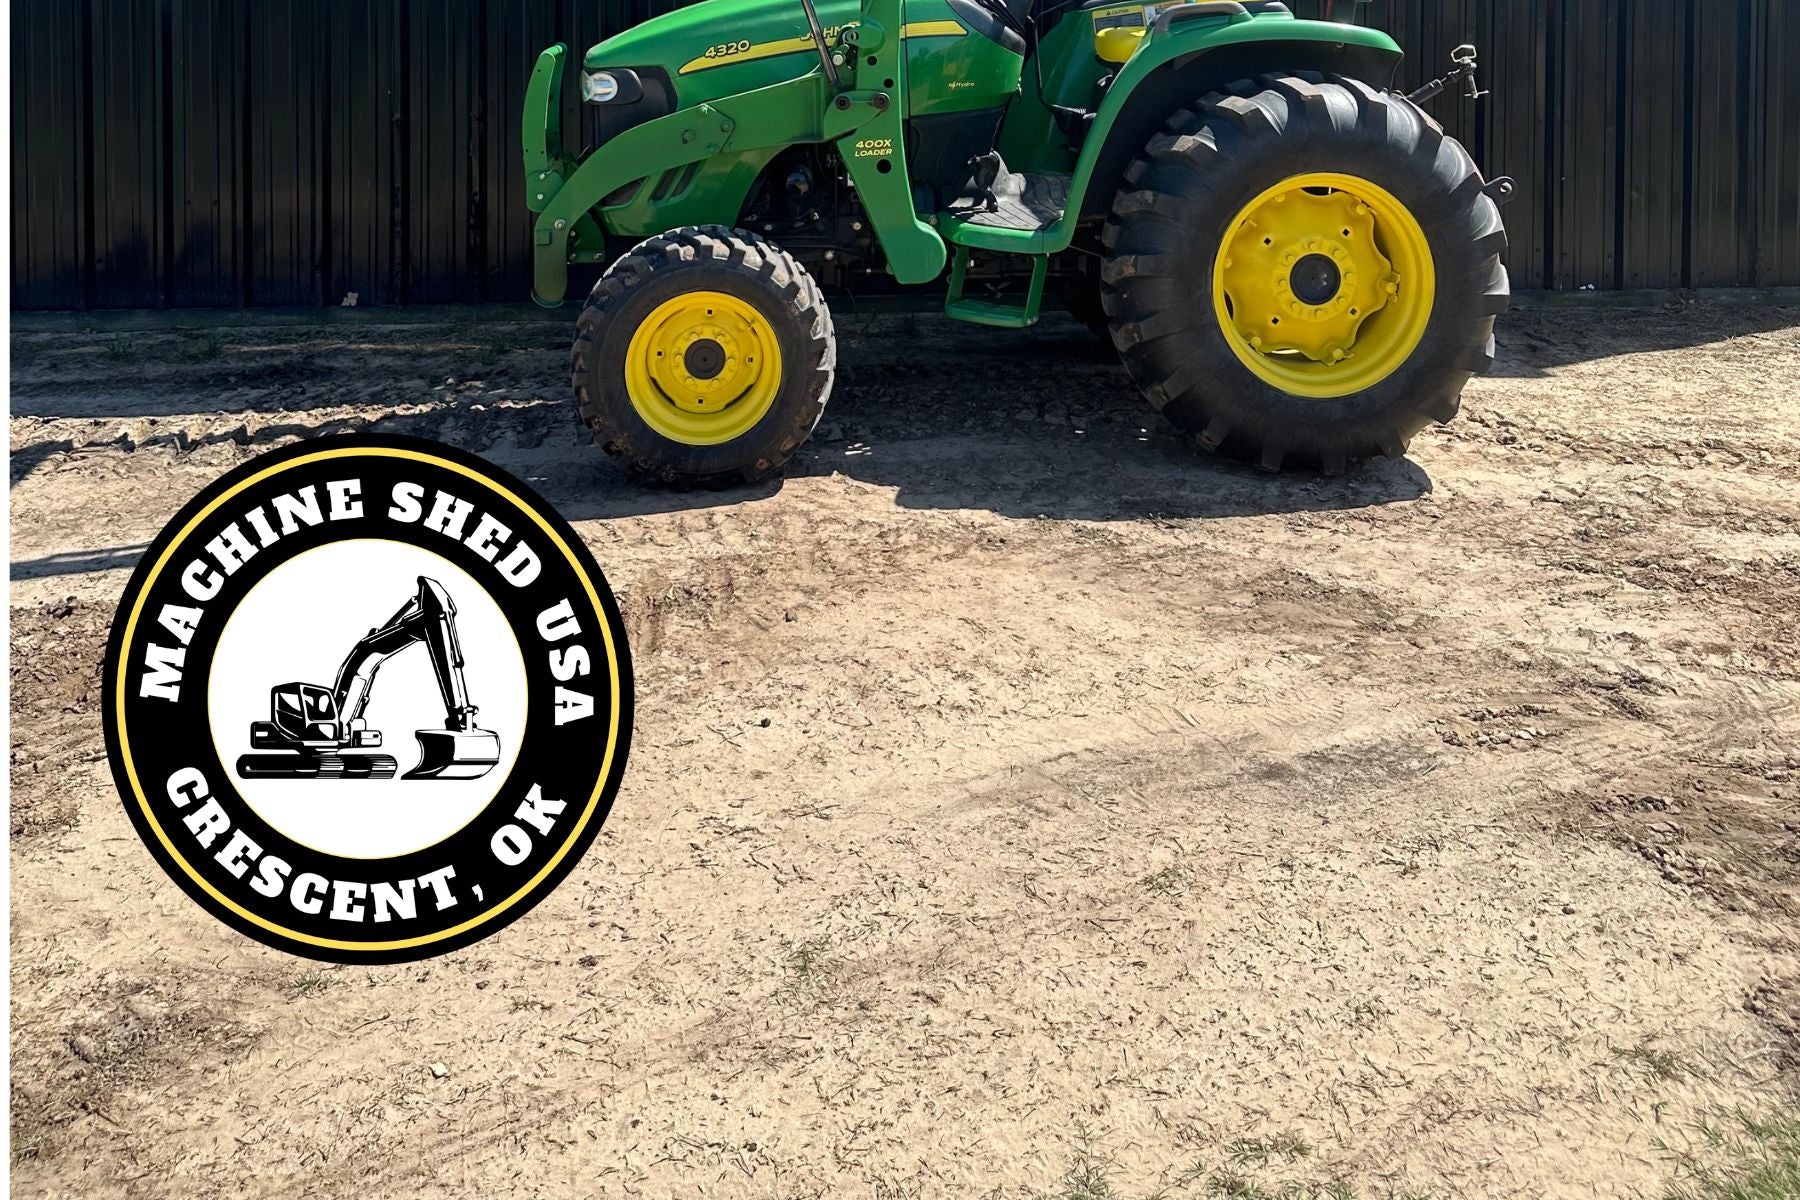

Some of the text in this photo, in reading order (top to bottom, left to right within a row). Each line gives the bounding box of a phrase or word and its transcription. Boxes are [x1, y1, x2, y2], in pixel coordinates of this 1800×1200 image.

[704, 39, 751, 58] 4320
[855, 138, 892, 148] 400X
[854, 148, 893, 157] LOADER
